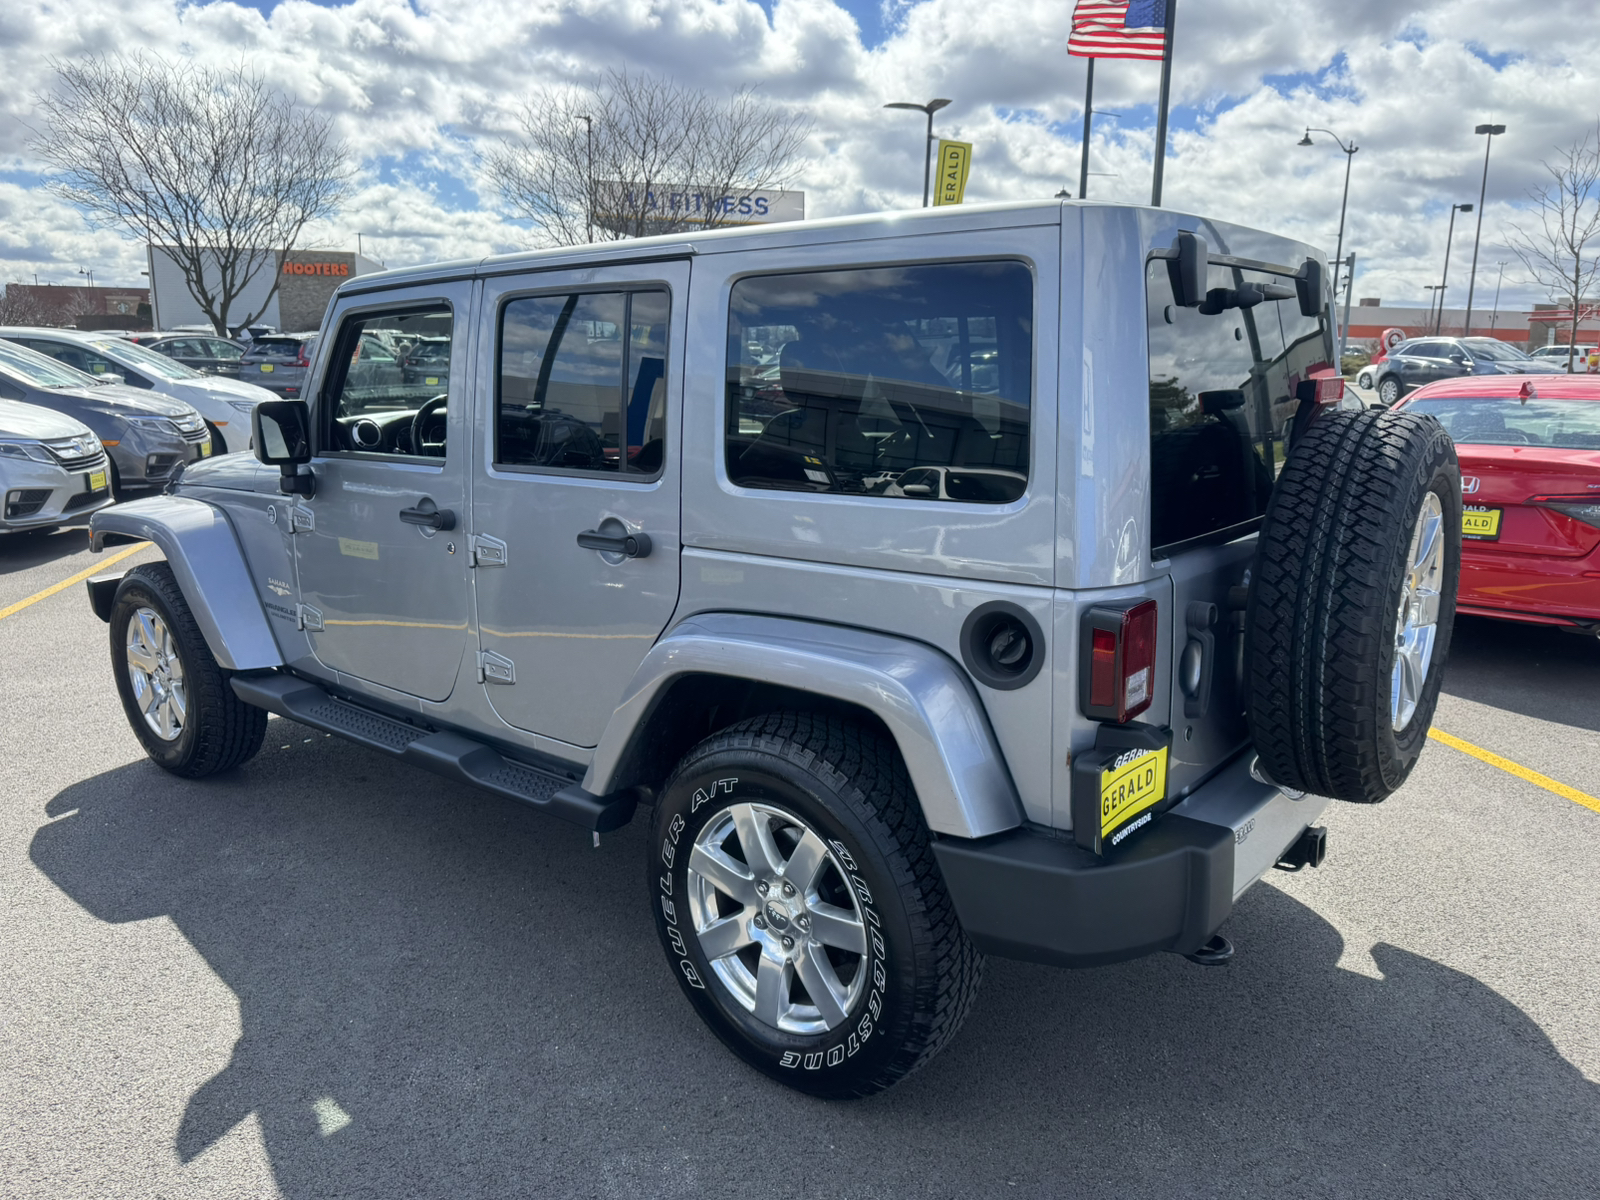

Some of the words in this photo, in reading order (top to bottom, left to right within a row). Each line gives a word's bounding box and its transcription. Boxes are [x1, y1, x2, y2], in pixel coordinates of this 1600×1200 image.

[945, 151, 960, 202] ERALD
[670, 191, 769, 216] FITNESS
[282, 261, 349, 277] HOOTERS
[1462, 504, 1487, 512] RALD
[1464, 518, 1489, 528] ALD
[268, 577, 290, 590] SAHARA
[271, 611, 296, 623] UNLIMITED
[1102, 768, 1154, 817] GERALD
[1112, 812, 1152, 846] COUNTRYSIDE
[1235, 818, 1256, 843] ERALD
[660, 813, 706, 989] DUELER
[691, 778, 738, 813] A/T
[779, 839, 886, 1070] BRIDGESTONE
